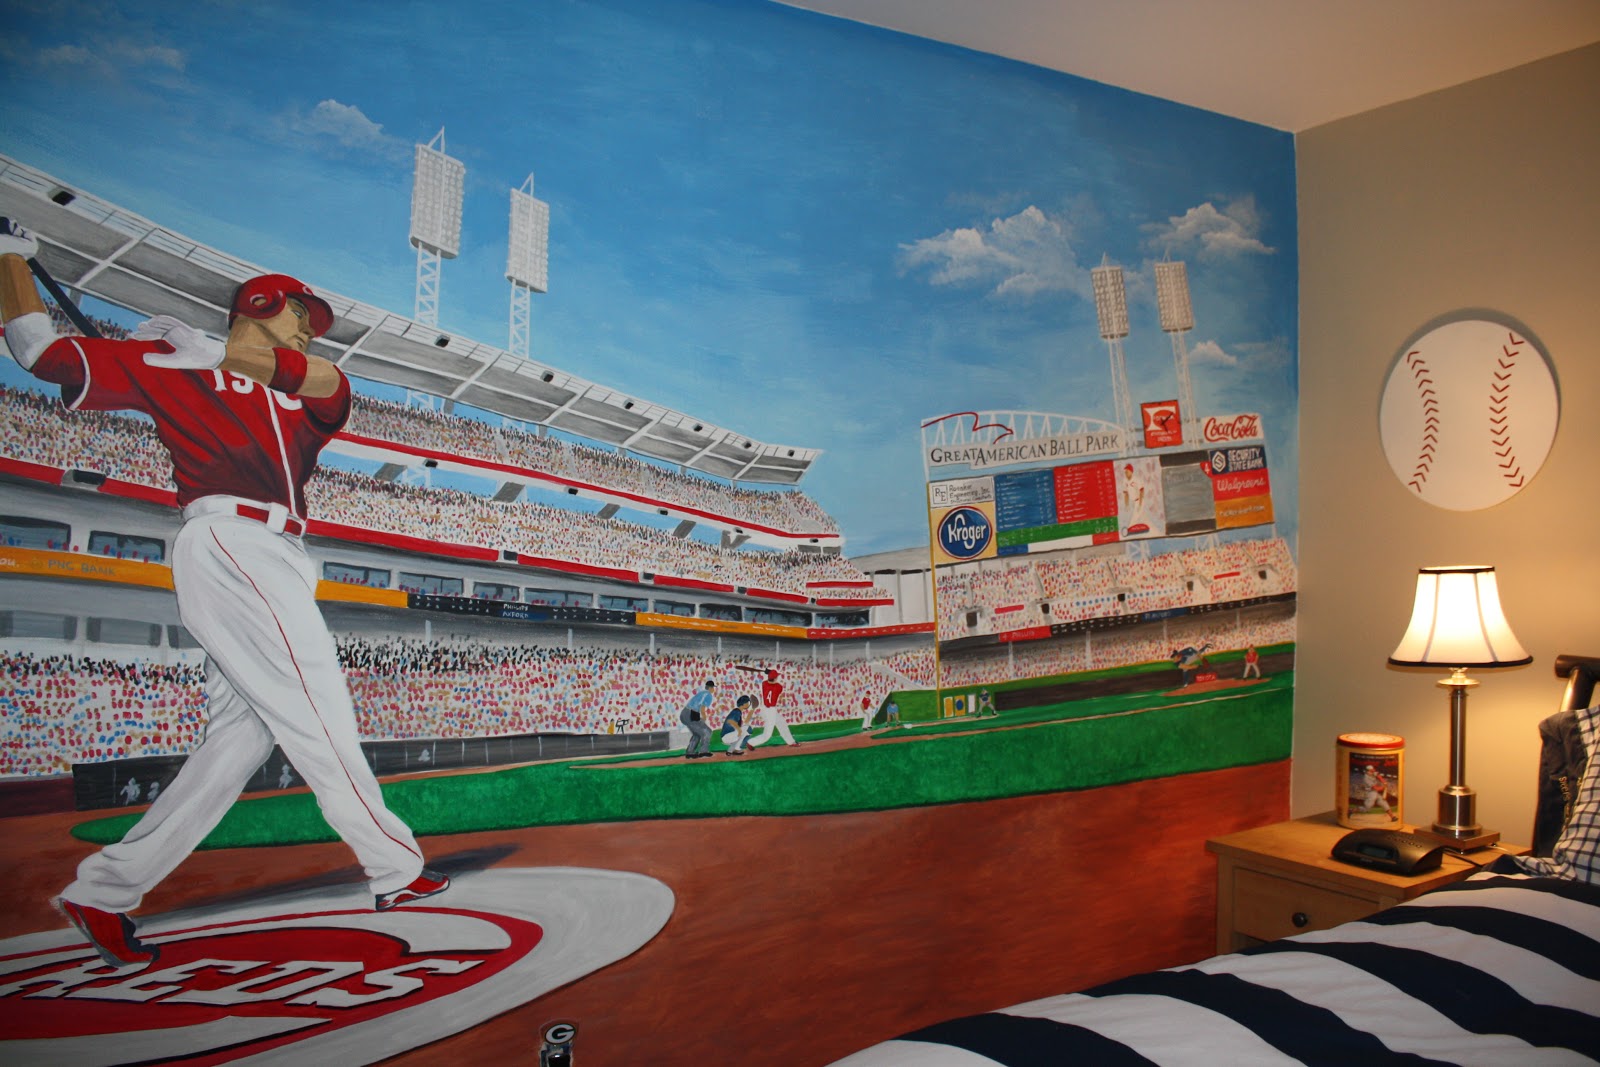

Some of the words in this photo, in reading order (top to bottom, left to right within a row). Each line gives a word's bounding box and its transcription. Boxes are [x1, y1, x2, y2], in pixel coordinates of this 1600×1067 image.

[1050, 440, 1084, 456] BALL
[1086, 435, 1120, 452] PARK
[1228, 448, 1261, 462] SECURITY
[1229, 460, 1247, 472] STATE
[1247, 457, 1264, 470] BANK
[1217, 477, 1265, 493] Walgreens
[947, 513, 987, 549] Kroger
[48, 559, 75, 571] PNC
[81, 564, 116, 577] BANK
[545, 1023, 576, 1044] G
